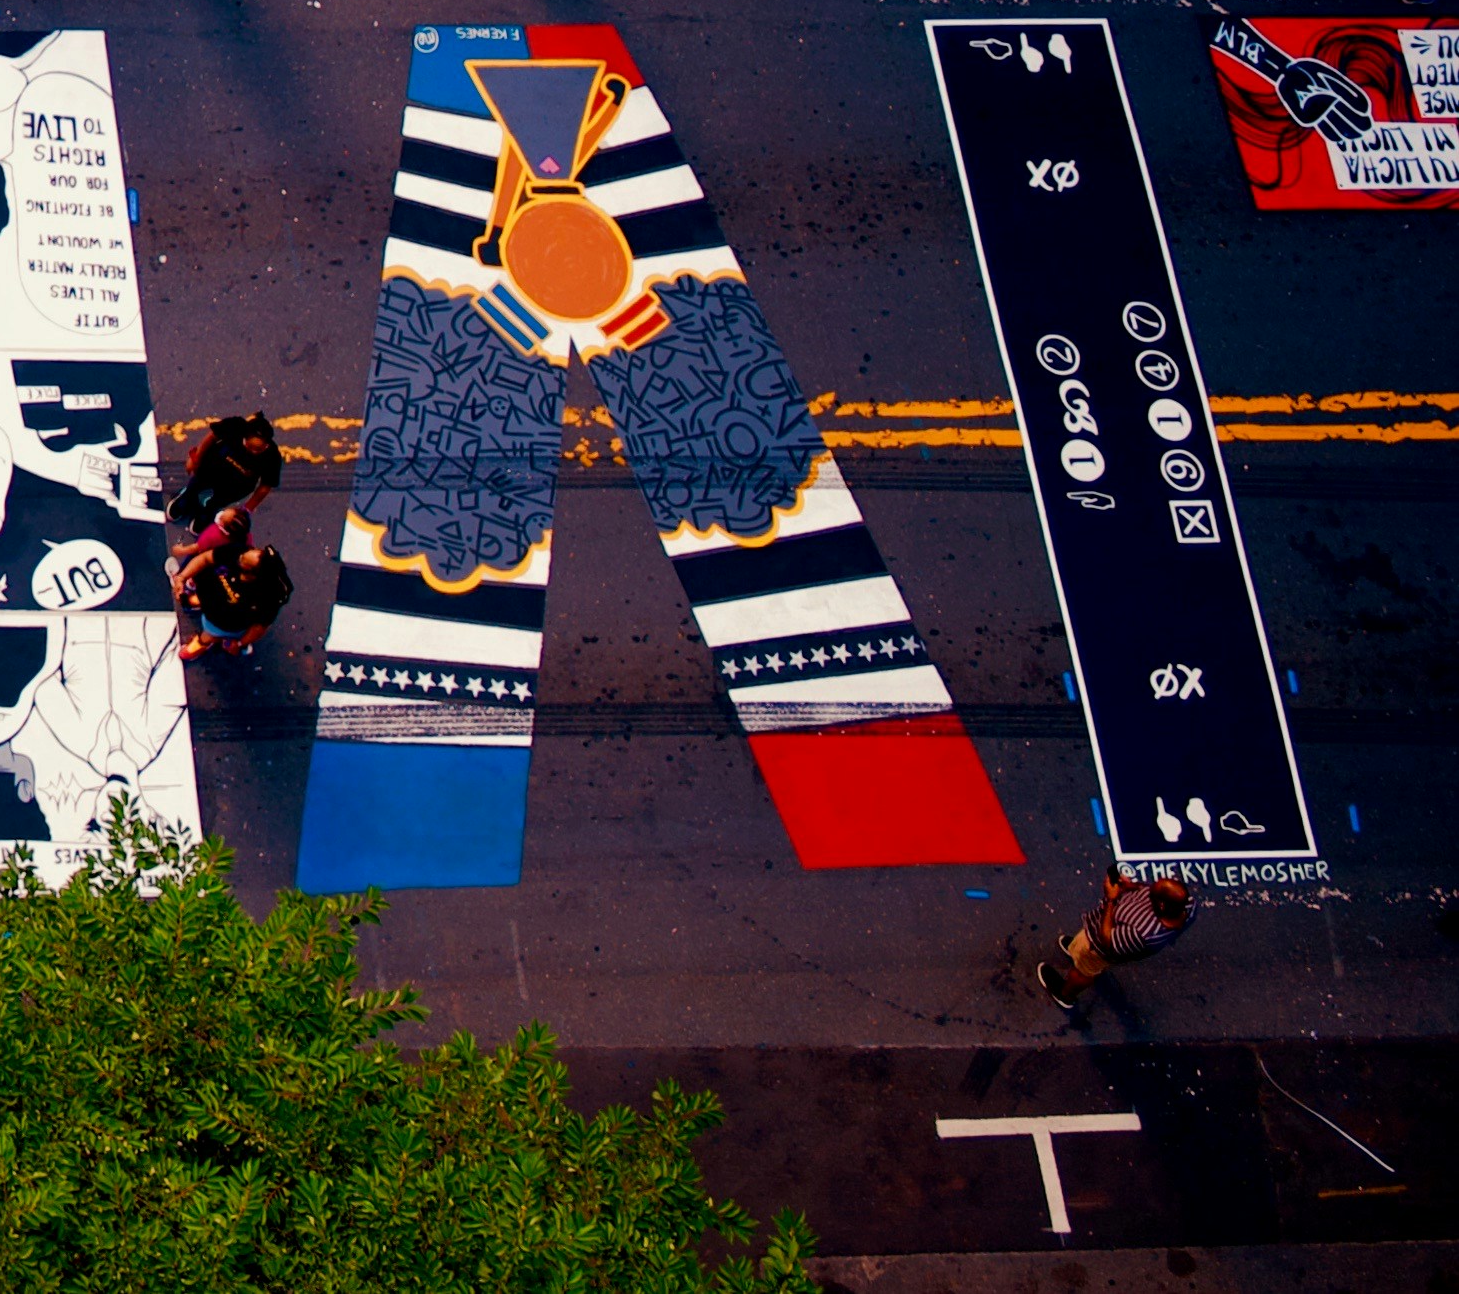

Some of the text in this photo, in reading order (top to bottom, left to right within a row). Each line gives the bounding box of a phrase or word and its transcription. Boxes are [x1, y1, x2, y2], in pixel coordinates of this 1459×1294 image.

[1213, 20, 1266, 65] BLM
[22, 112, 105, 142] TO LIVE
[1422, 127, 1455, 152] MI
[33, 144, 106, 167] RIGHTS
[1343, 155, 1429, 185] LUCHA
[49, 175, 109, 191] FOR OUR
[25, 199, 114, 218] BE FIGHTING
[109, 239, 124, 250] WE
[28, 259, 127, 281] REALLY MATTER
[50, 284, 120, 303] ALL LIVES
[75, 314, 119, 328] BUT IF
